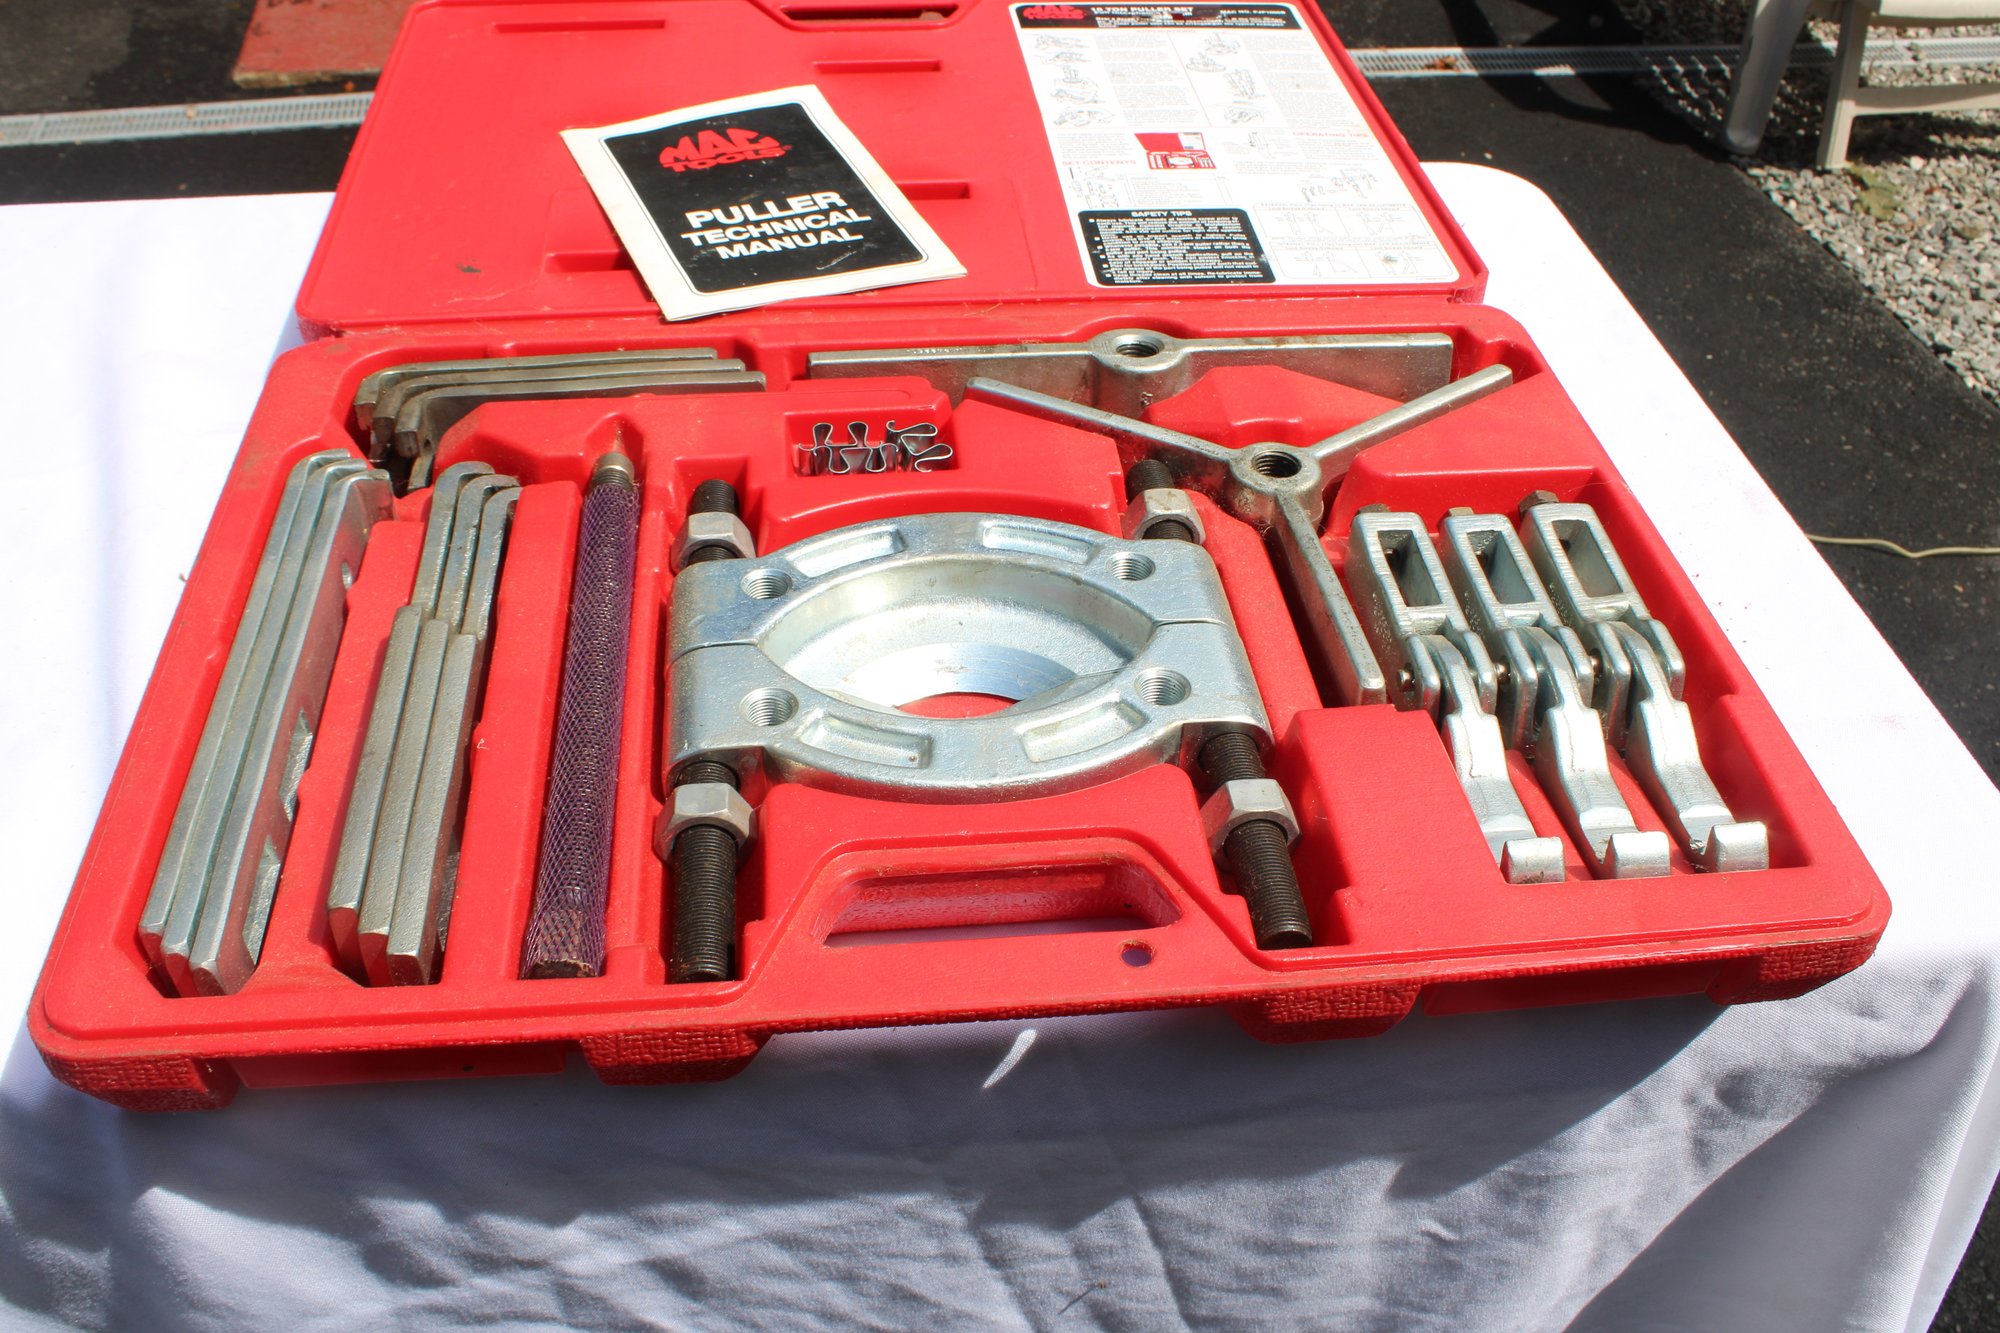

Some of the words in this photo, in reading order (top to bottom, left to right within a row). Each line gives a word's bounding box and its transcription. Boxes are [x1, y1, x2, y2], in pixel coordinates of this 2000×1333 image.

[659, 128, 781, 164] MAC
[662, 147, 786, 173] TOOLS
[680, 208, 872, 247] TECHNICAL
[684, 191, 848, 229] PULLER
[715, 228, 865, 260] MANUAL
